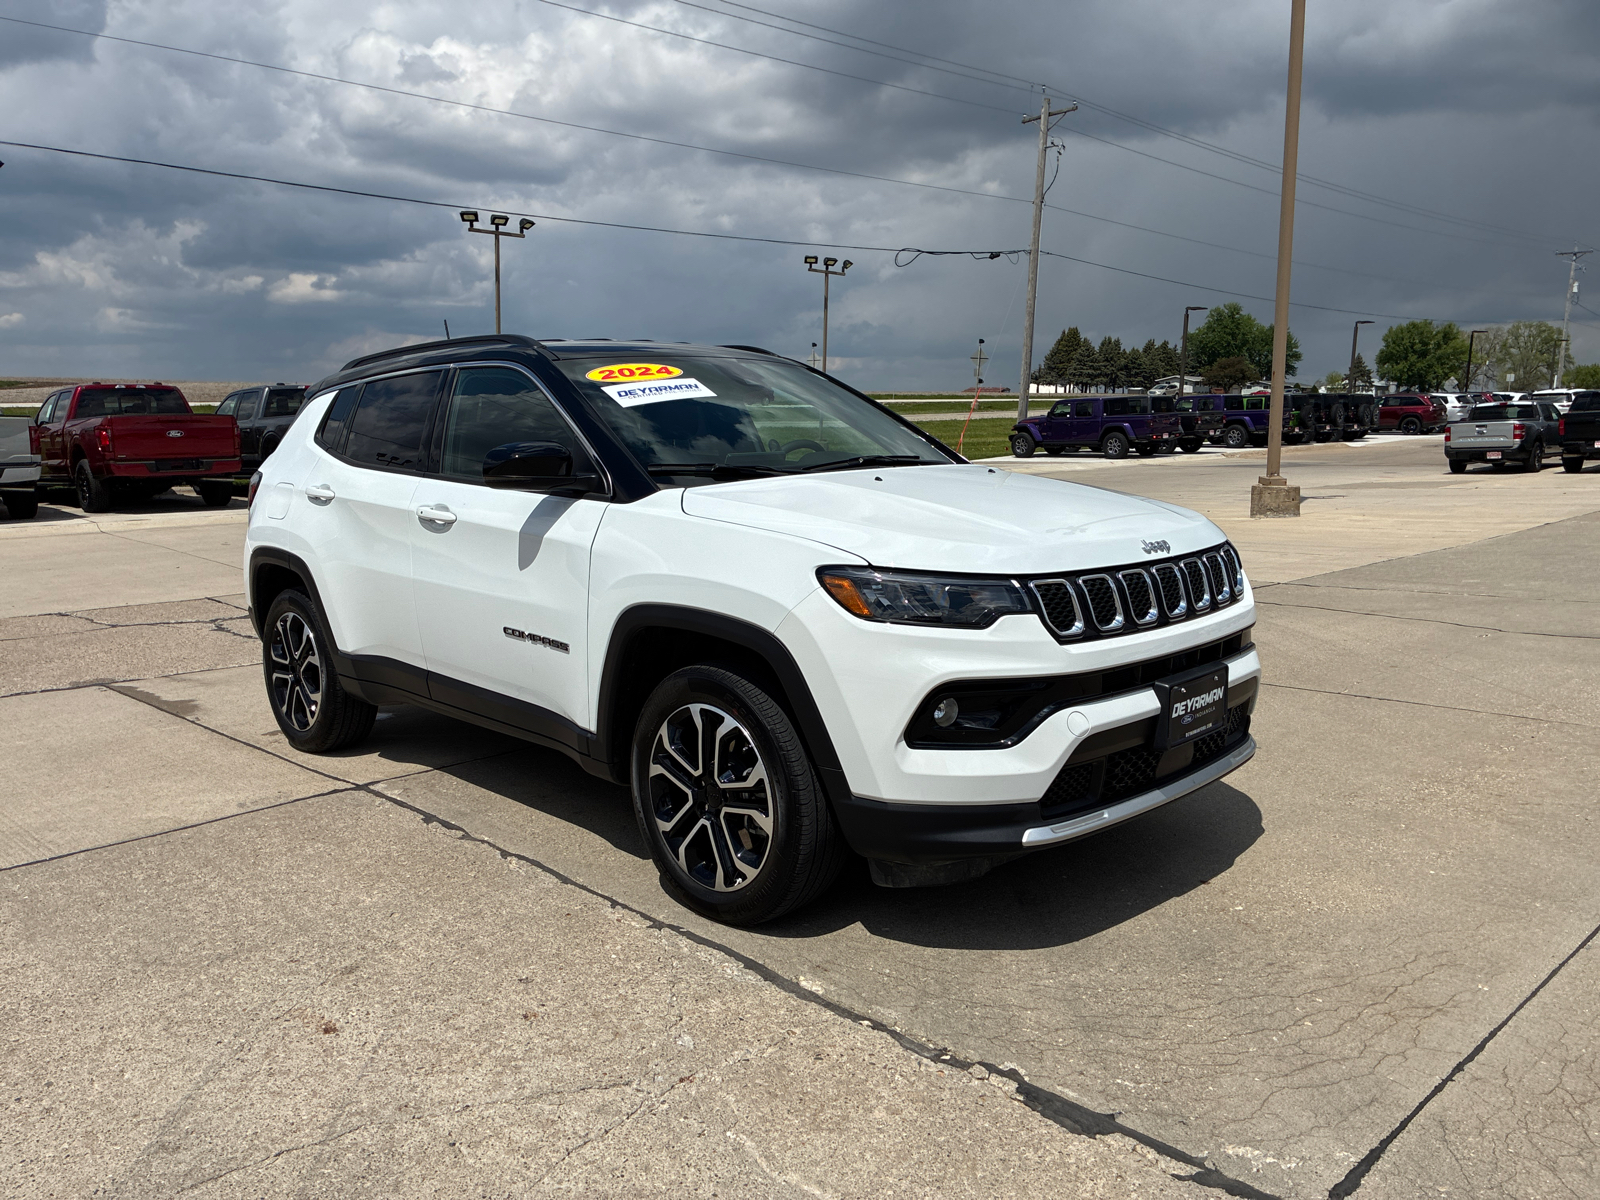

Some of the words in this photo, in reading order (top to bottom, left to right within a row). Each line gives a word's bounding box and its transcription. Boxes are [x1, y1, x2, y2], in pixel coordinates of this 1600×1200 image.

[598, 366, 674, 380] 2024
[617, 383, 699, 398] DEYARMAN
[627, 392, 663, 400] CERTIFIED
[1140, 539, 1170, 554] Jeep
[503, 626, 570, 652] COMPASS
[1172, 686, 1224, 718] DEYARMAN
[1194, 706, 1216, 718] INDIANOLA
